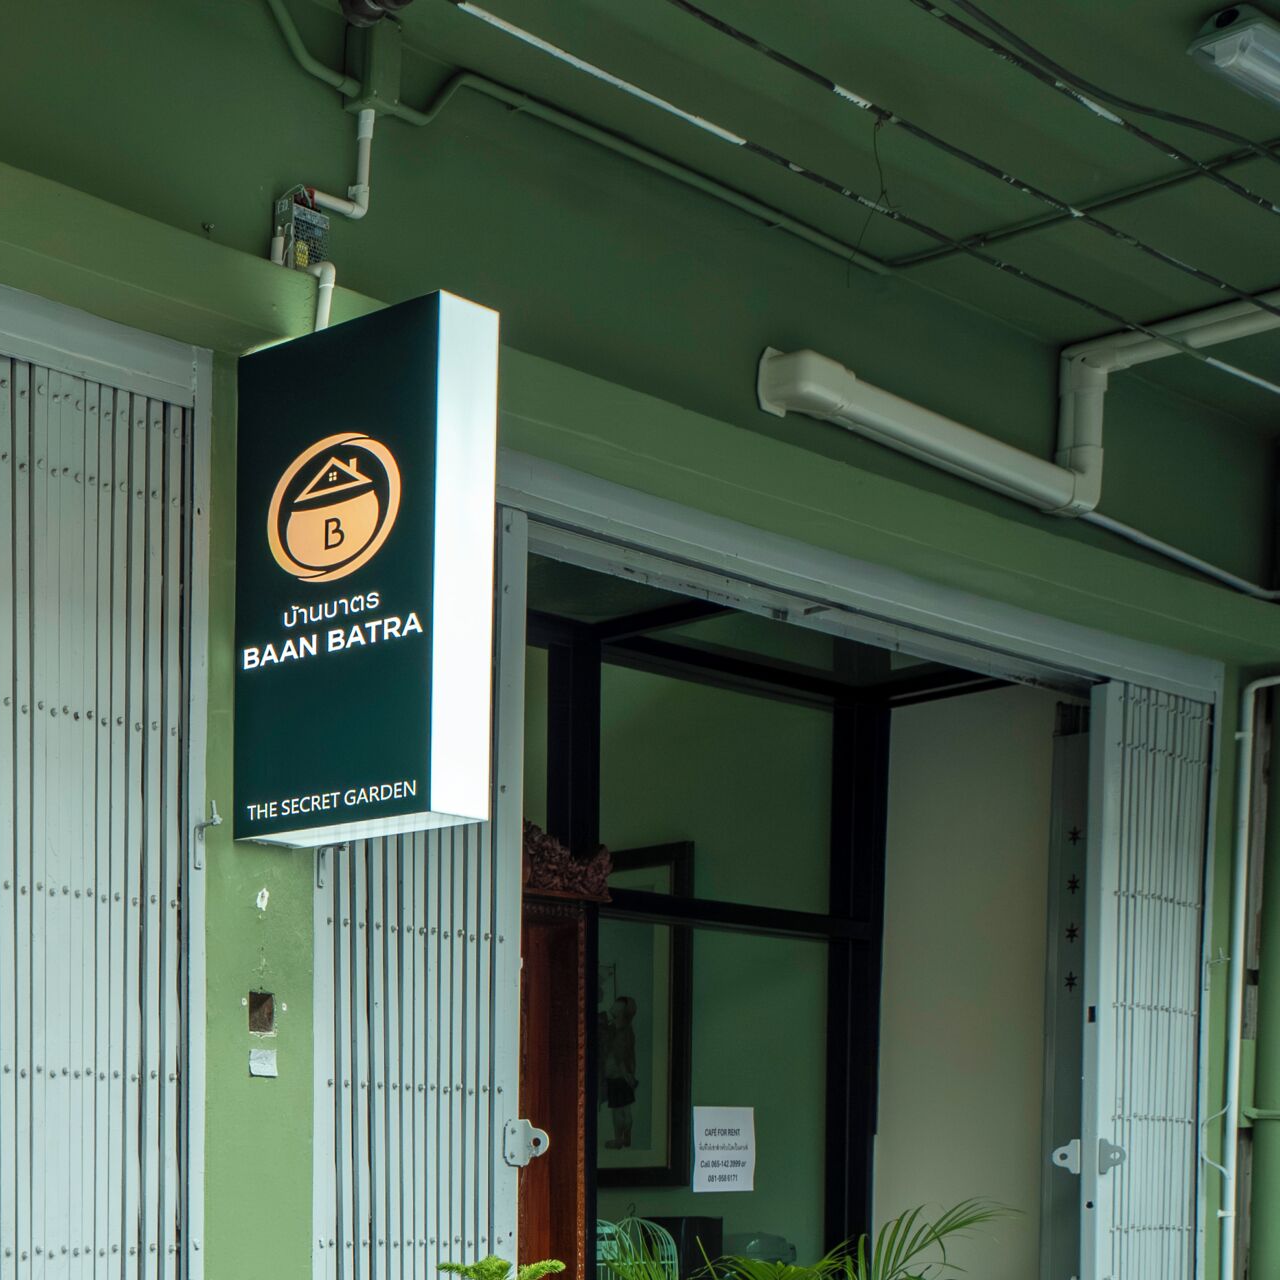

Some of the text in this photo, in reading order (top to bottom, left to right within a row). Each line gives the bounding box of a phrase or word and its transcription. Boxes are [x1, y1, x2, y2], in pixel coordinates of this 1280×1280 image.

[324, 517, 345, 551] B
[283, 591, 380, 628] บ้านบาตร
[243, 612, 423, 670] BAAN BATRA
[247, 779, 417, 821] THE SECRET GARDEN
[718, 1128, 727, 1136] FOR
[728, 1128, 741, 1136] RENT
